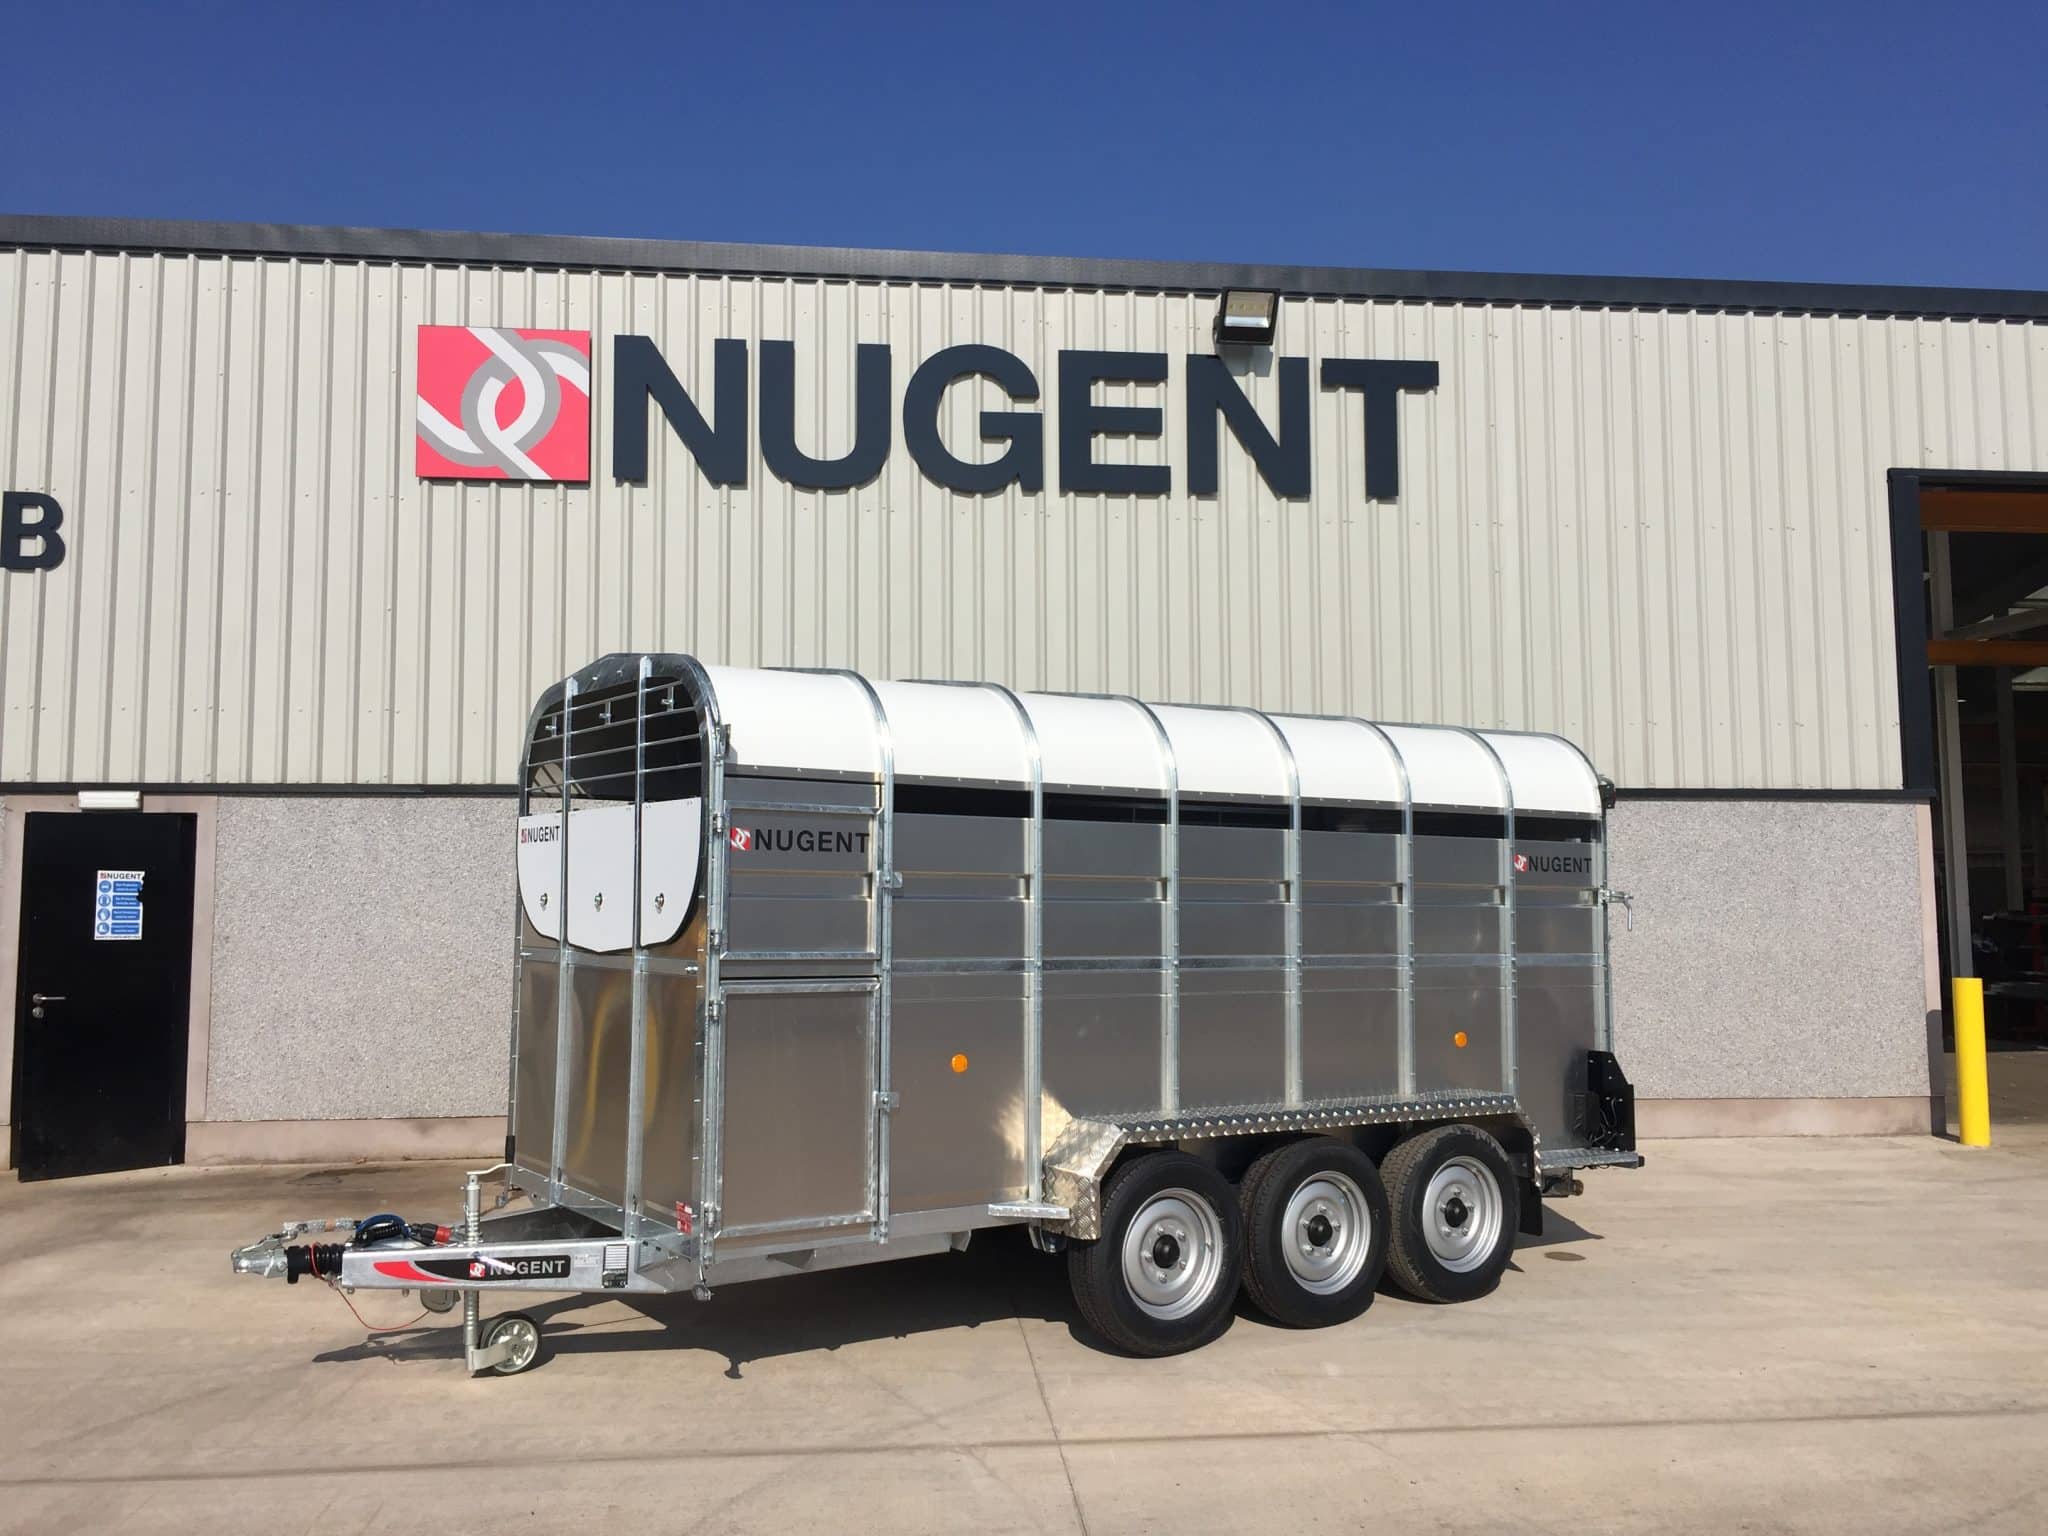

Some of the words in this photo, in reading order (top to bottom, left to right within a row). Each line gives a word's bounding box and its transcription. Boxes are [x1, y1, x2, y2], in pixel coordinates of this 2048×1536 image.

[613, 334, 1439, 503] NUGENT
[0, 491, 66, 573] B
[527, 825, 560, 843] NUGENT
[755, 829, 870, 853] NUGENT
[1528, 856, 1592, 873] NUGENT
